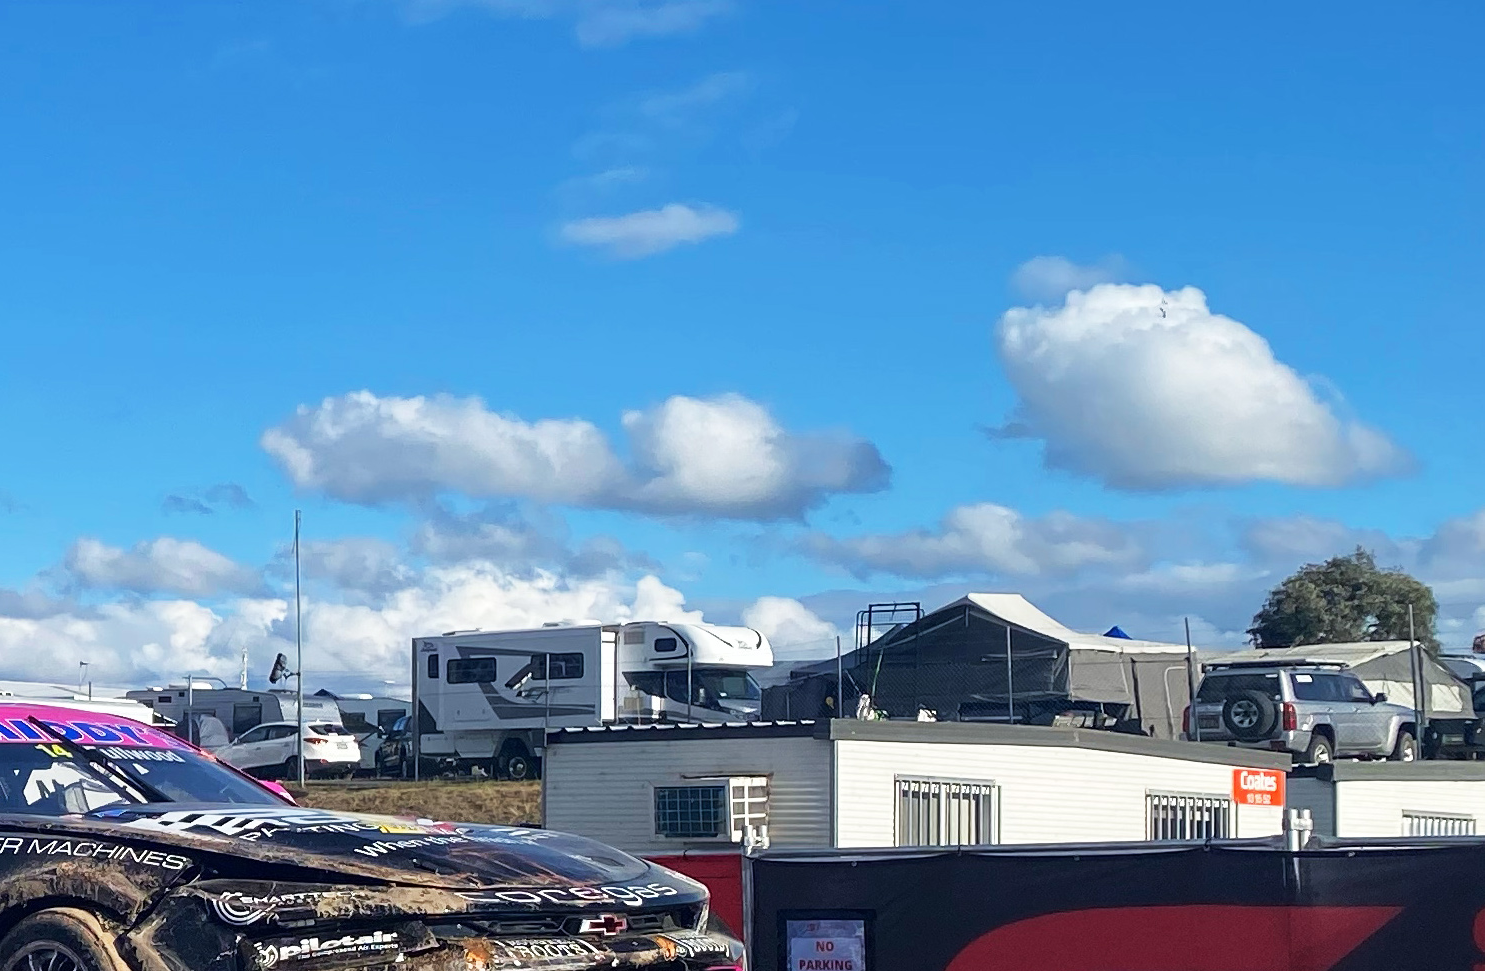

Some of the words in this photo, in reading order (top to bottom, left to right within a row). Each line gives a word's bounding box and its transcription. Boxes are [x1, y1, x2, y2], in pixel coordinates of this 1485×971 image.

[34, 743, 73, 759] 14
[84, 745, 186, 763] ullwood
[1241, 771, 1277, 791] Coates
[27, 839, 187, 870] MACHINES
[356, 837, 424, 857] When
[279, 931, 397, 960] pilotair
[816, 941, 834, 952] NO
[799, 960, 852, 970] PARKING
